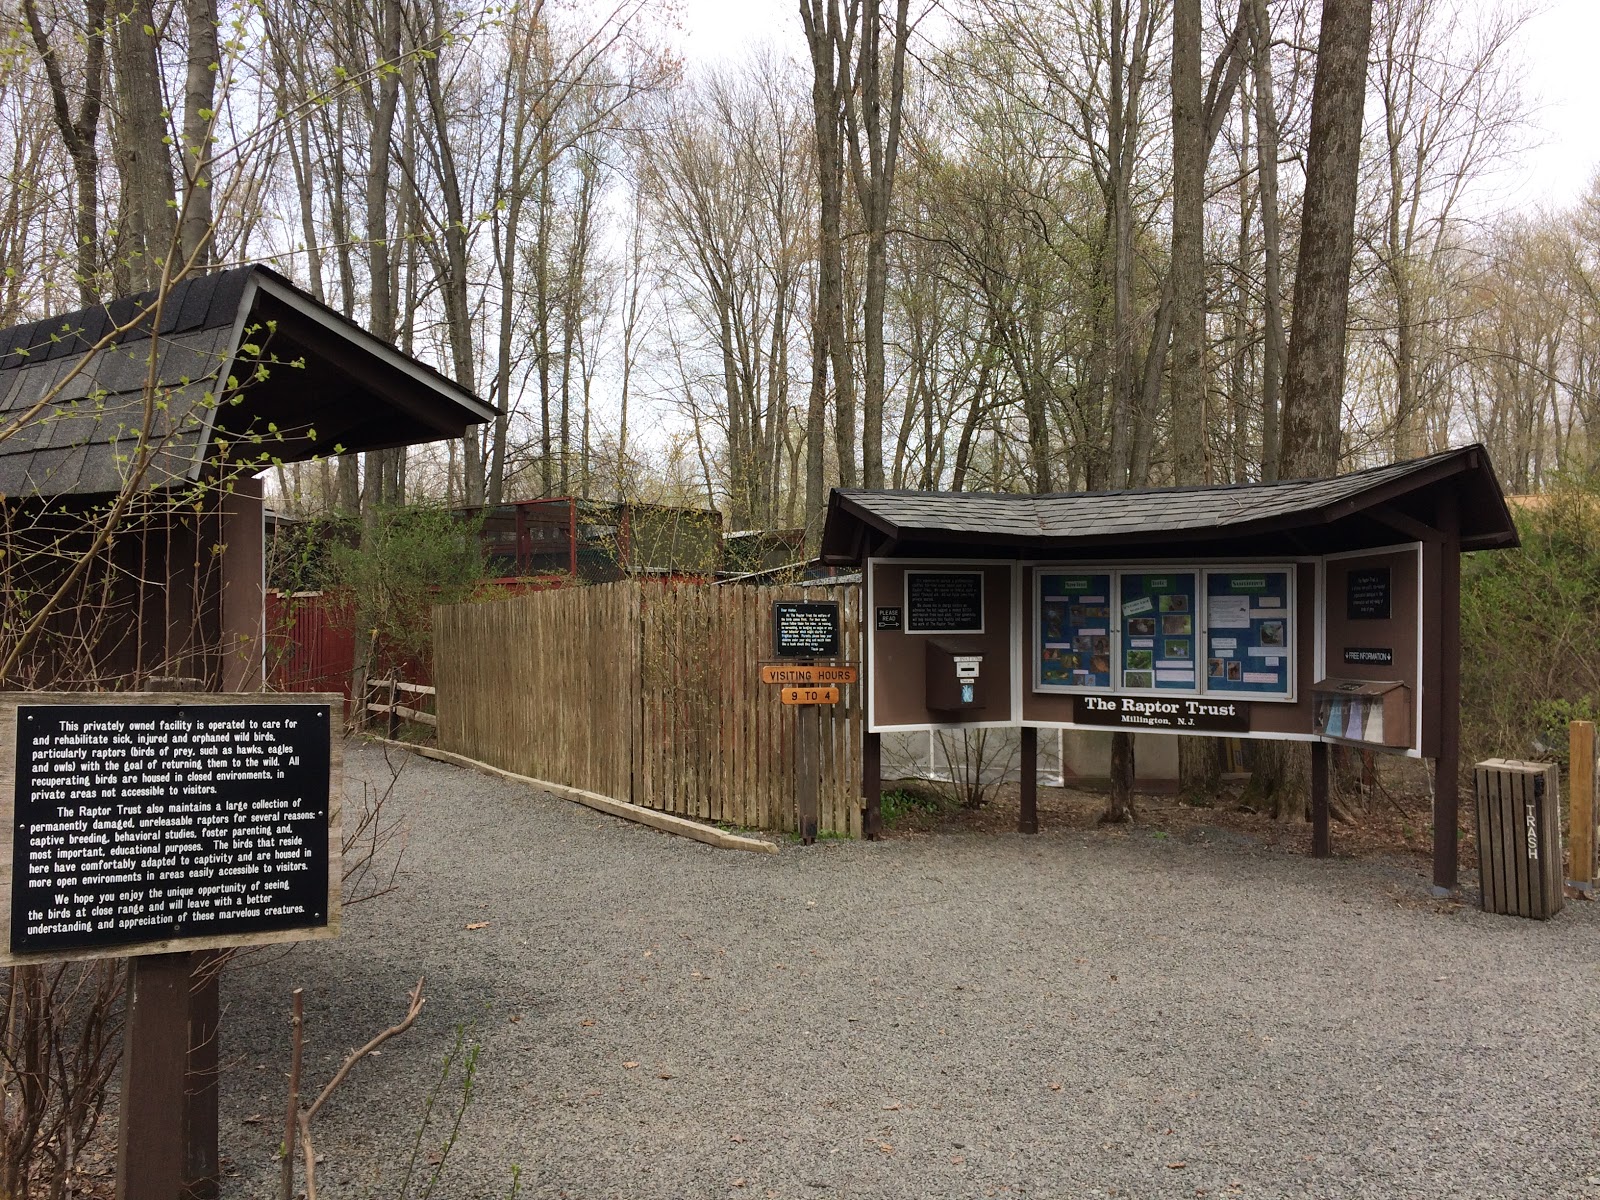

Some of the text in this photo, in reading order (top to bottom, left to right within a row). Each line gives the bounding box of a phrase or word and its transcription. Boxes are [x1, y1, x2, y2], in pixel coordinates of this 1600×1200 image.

[1348, 651, 1359, 660] FREE
[770, 671, 851, 681] VISITING HOURS
[791, 691, 831, 701] 9 TO 4
[1084, 697, 1236, 716] The Raptor Trust
[58, 718, 297, 733] This privately owned facility is operated to care for
[32, 734, 49, 745] and
[54, 733, 108, 744] rehabilitate
[137, 732, 167, 745] injured
[171, 732, 187, 743] and
[191, 731, 229, 744] orphaned
[233, 731, 249, 741] wild
[31, 747, 87, 761] particularly
[91, 747, 126, 759] raptors
[130, 746, 154, 757] (birds
[158, 745, 169, 756] of
[199, 744, 218, 755] such
[221, 746, 232, 754] as
[267, 743, 293, 755] eagles
[31, 755, 299, 772] and owls) with the goal of returning them to the wild. All
[31, 774, 90, 788] recuperating
[95, 773, 117, 784] birds
[121, 775, 137, 783] are
[141, 771, 170, 783] housed
[174, 771, 182, 781] in
[187, 770, 212, 781] closed
[276, 768, 284, 778] in
[30, 783, 217, 802] private areas not accessible to visitors.
[56, 806, 74, 817] The
[78, 805, 111, 818] Raptor
[116, 804, 141, 814] Trust
[146, 803, 164, 814] also
[168, 801, 211, 812] maintains
[225, 800, 247, 811] large
[251, 798, 288, 809] collection
[292, 797, 301, 807] of
[30, 819, 88, 834] permanently
[139, 815, 192, 827] unreleasable
[196, 814, 229, 826] raptors
[233, 812, 246, 822] for
[250, 810, 279, 822] several
[283, 811, 315, 820] reasons:
[1526, 804, 1538, 860] TRASH
[29, 834, 64, 848] captive
[114, 829, 160, 842] behavioral
[201, 827, 228, 837] foster
[232, 824, 272, 838] parenting
[29, 848, 51, 861] most
[109, 842, 160, 855] educational
[164, 843, 203, 855] purposes.
[212, 839, 228, 849] The
[232, 838, 253, 849] birds
[256, 837, 275, 847] that
[278, 835, 302, 846] reside
[28, 847, 311, 873] here have comfortably adapted to captivity and are housed in
[28, 861, 308, 888] more open environments in areas easily accessible to visitors.
[54, 879, 289, 905] We hope you enjoy the unique opportunity of seeing
[27, 893, 272, 920] the birds at close range and will leave with a better
[27, 904, 304, 934] understanding and appreciation of these marvelous creatures.
